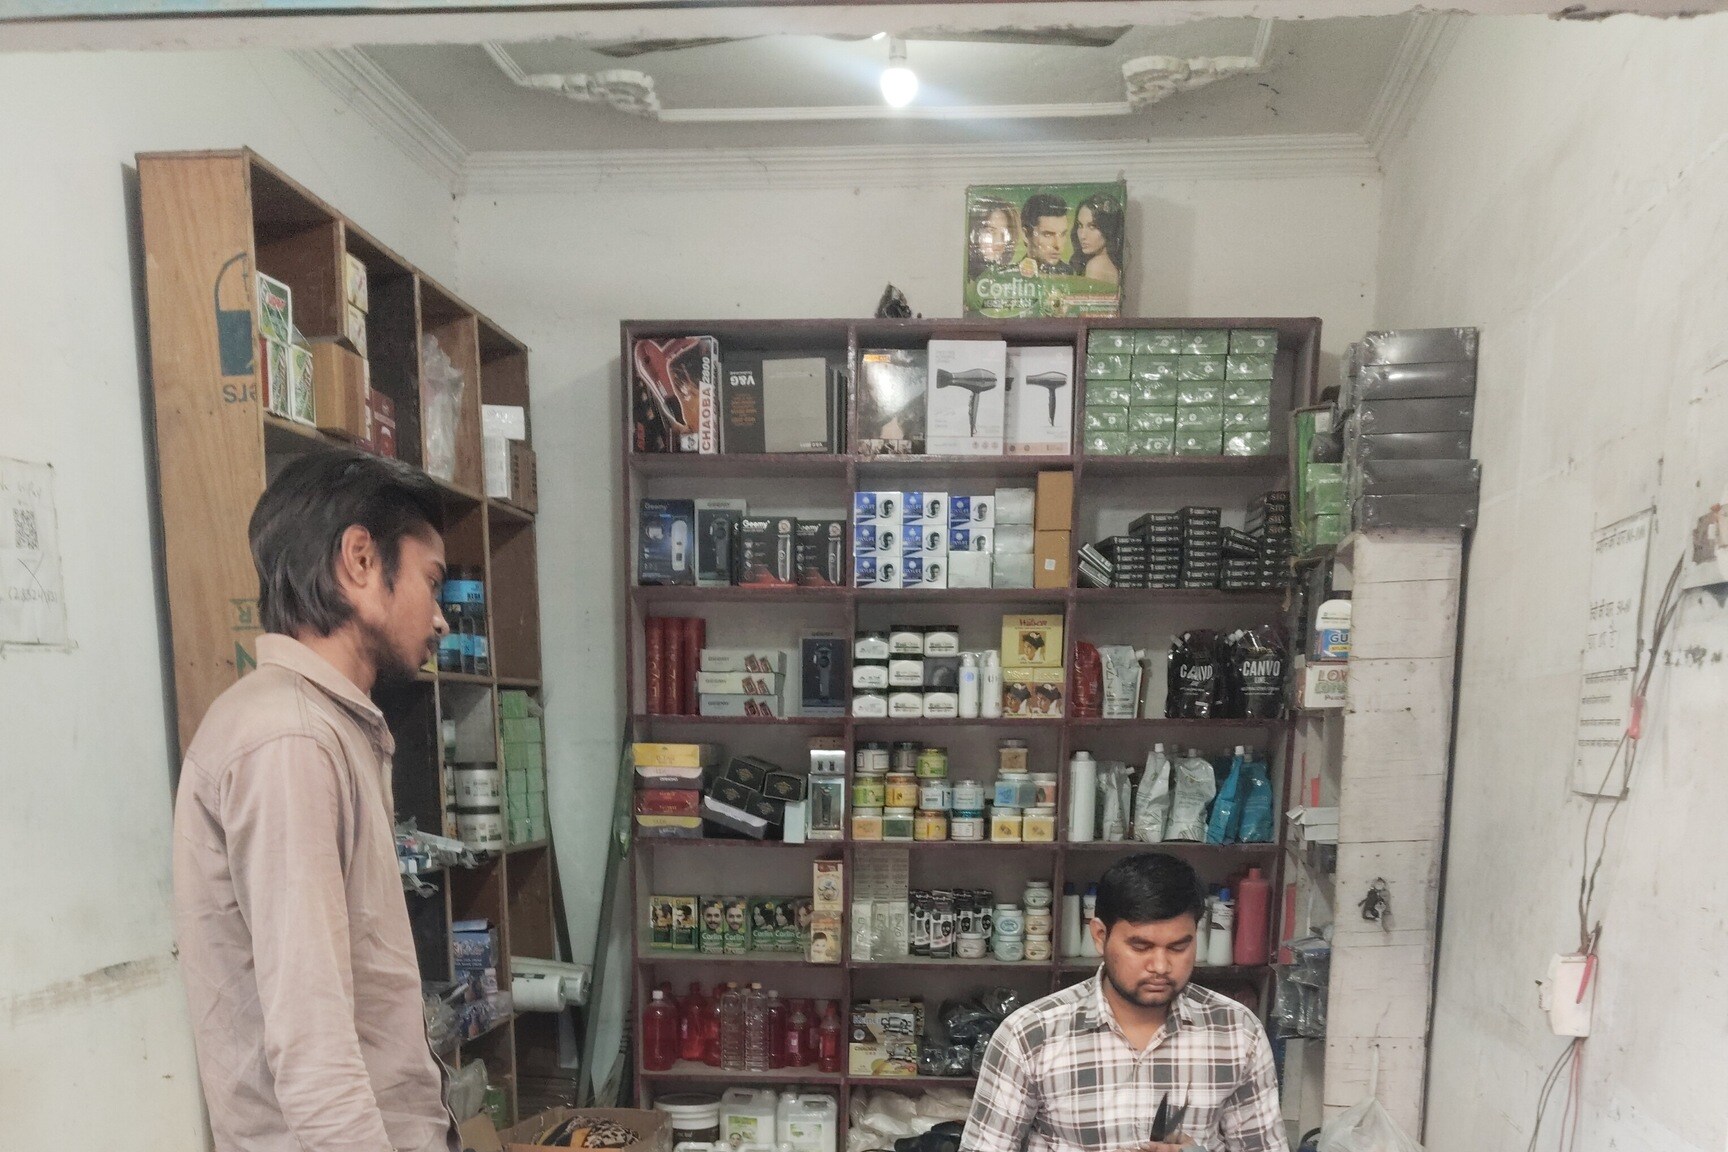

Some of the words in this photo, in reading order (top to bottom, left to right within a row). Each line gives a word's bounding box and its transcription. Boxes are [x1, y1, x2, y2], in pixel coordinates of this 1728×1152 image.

[702, 356, 711, 384] 2800
[729, 374, 755, 387] V&G
[702, 387, 711, 451] CHAOBA
[742, 519, 770, 531] Geemy
[1330, 634, 1348, 643] GU
[1242, 660, 1281, 677] CANVO
[1318, 670, 1348, 682] LOV
